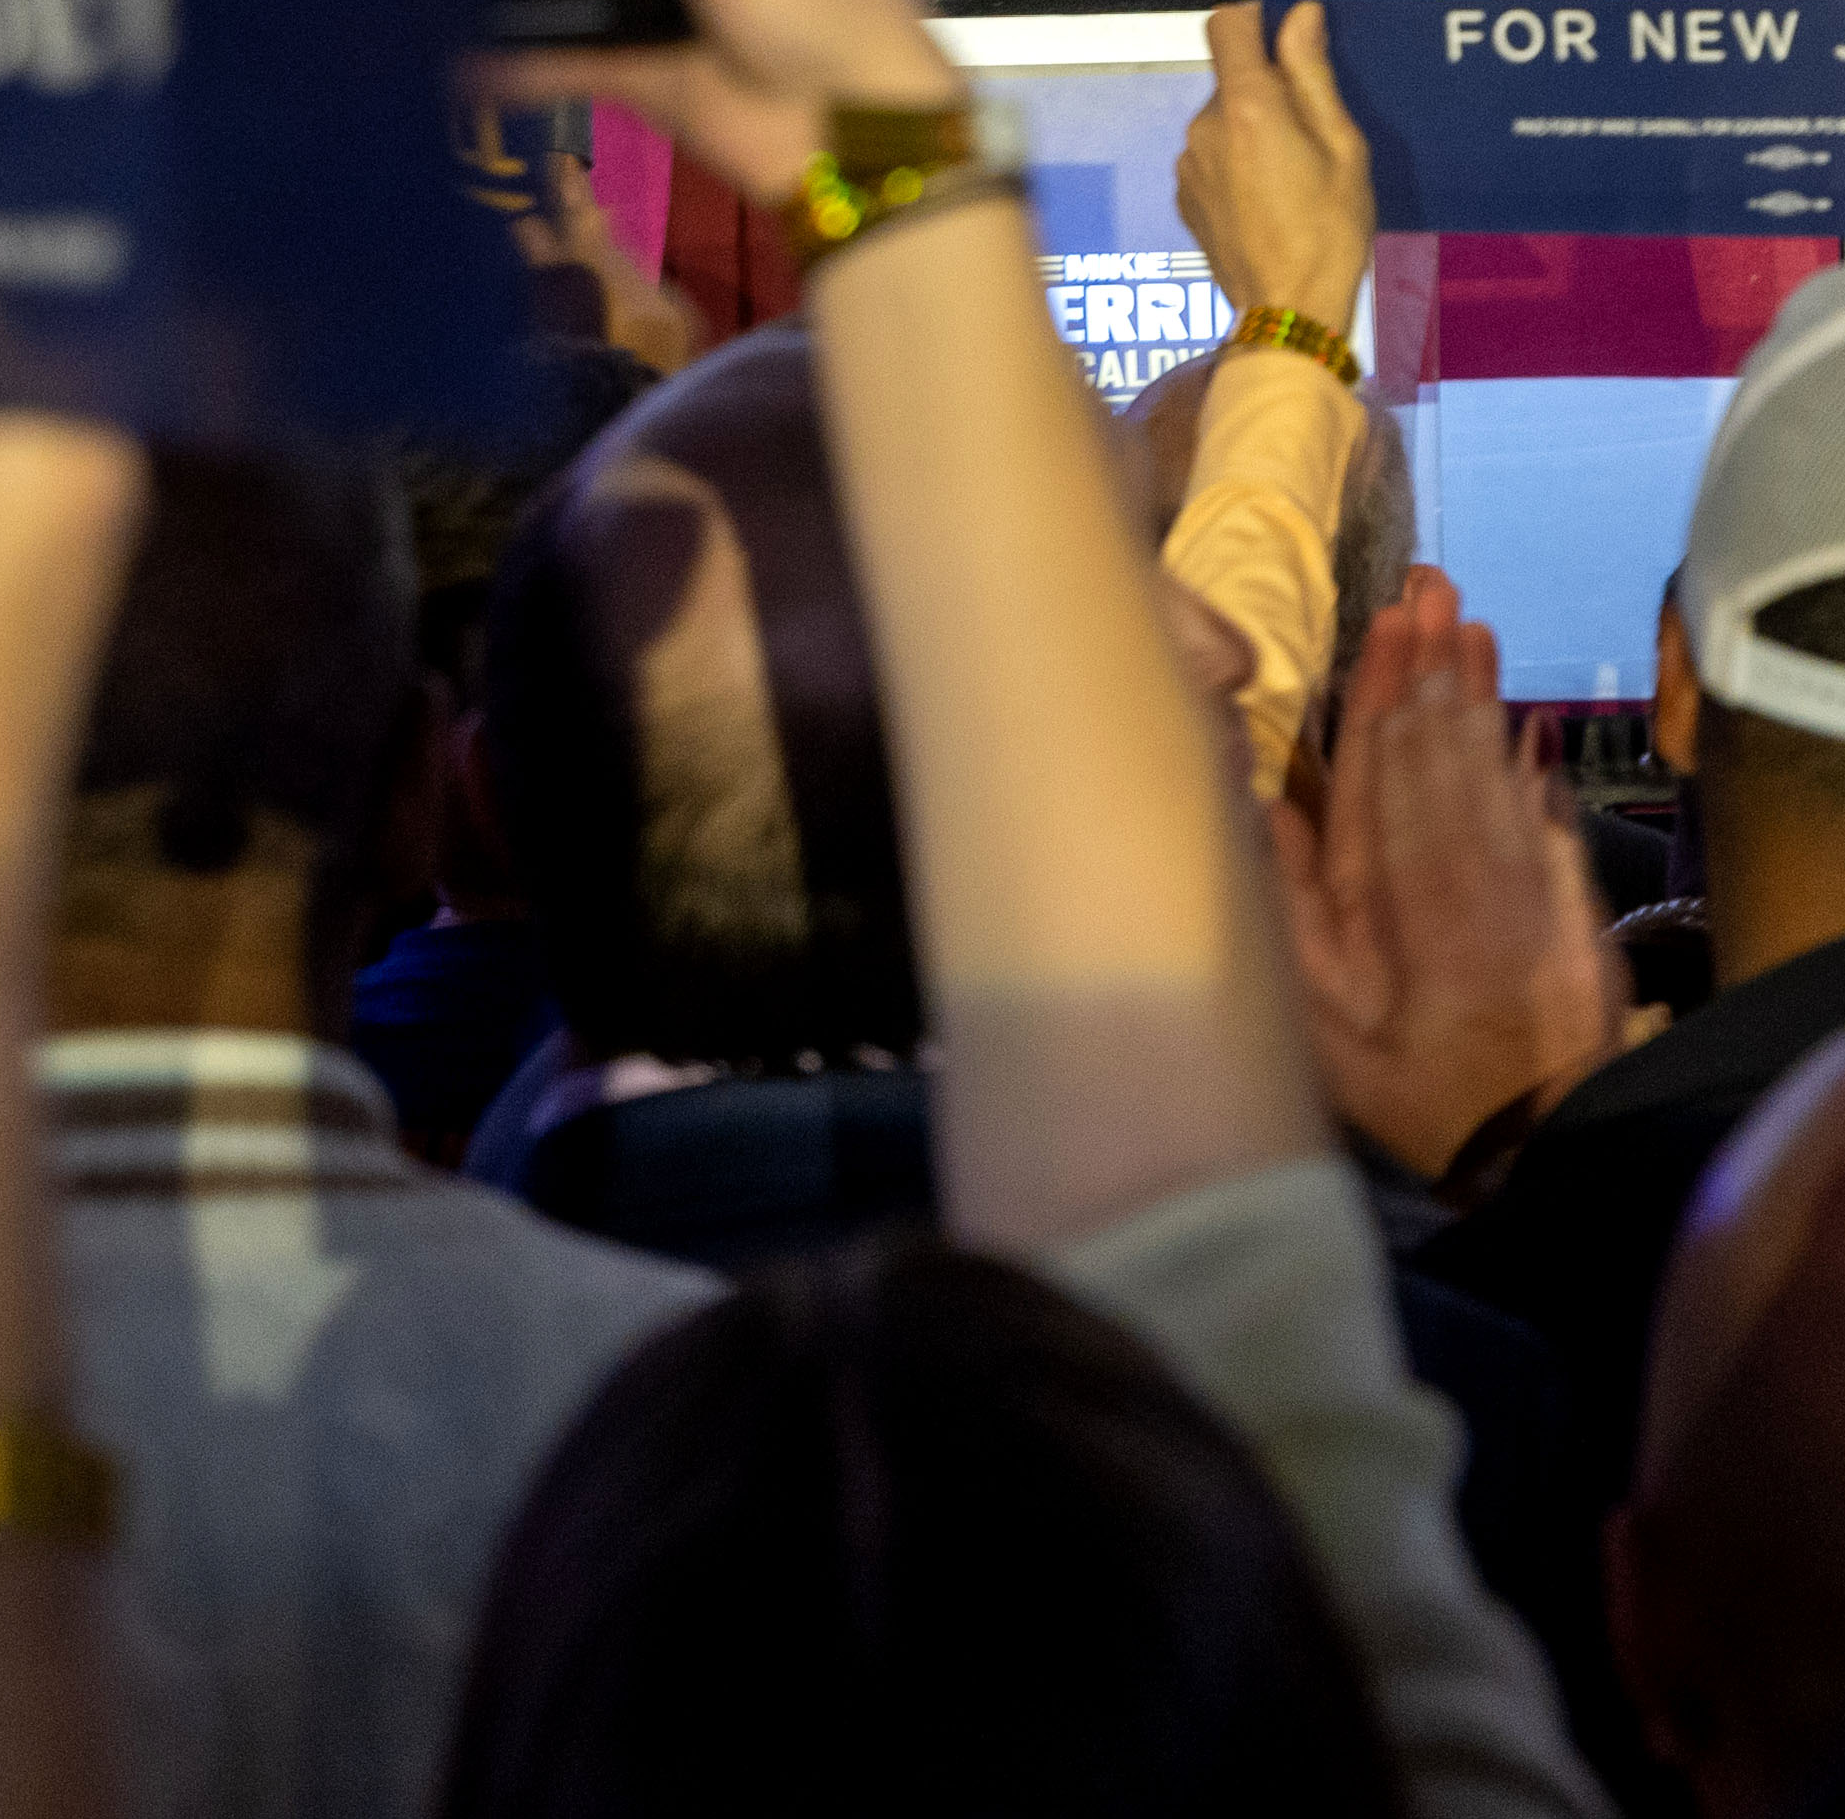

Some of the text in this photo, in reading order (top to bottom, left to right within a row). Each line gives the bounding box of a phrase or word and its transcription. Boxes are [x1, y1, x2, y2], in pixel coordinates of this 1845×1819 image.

[1445, 8, 1596, 62] FOR
[1631, 10, 1798, 61] NEW
[1063, 251, 1170, 281] MIKIE
